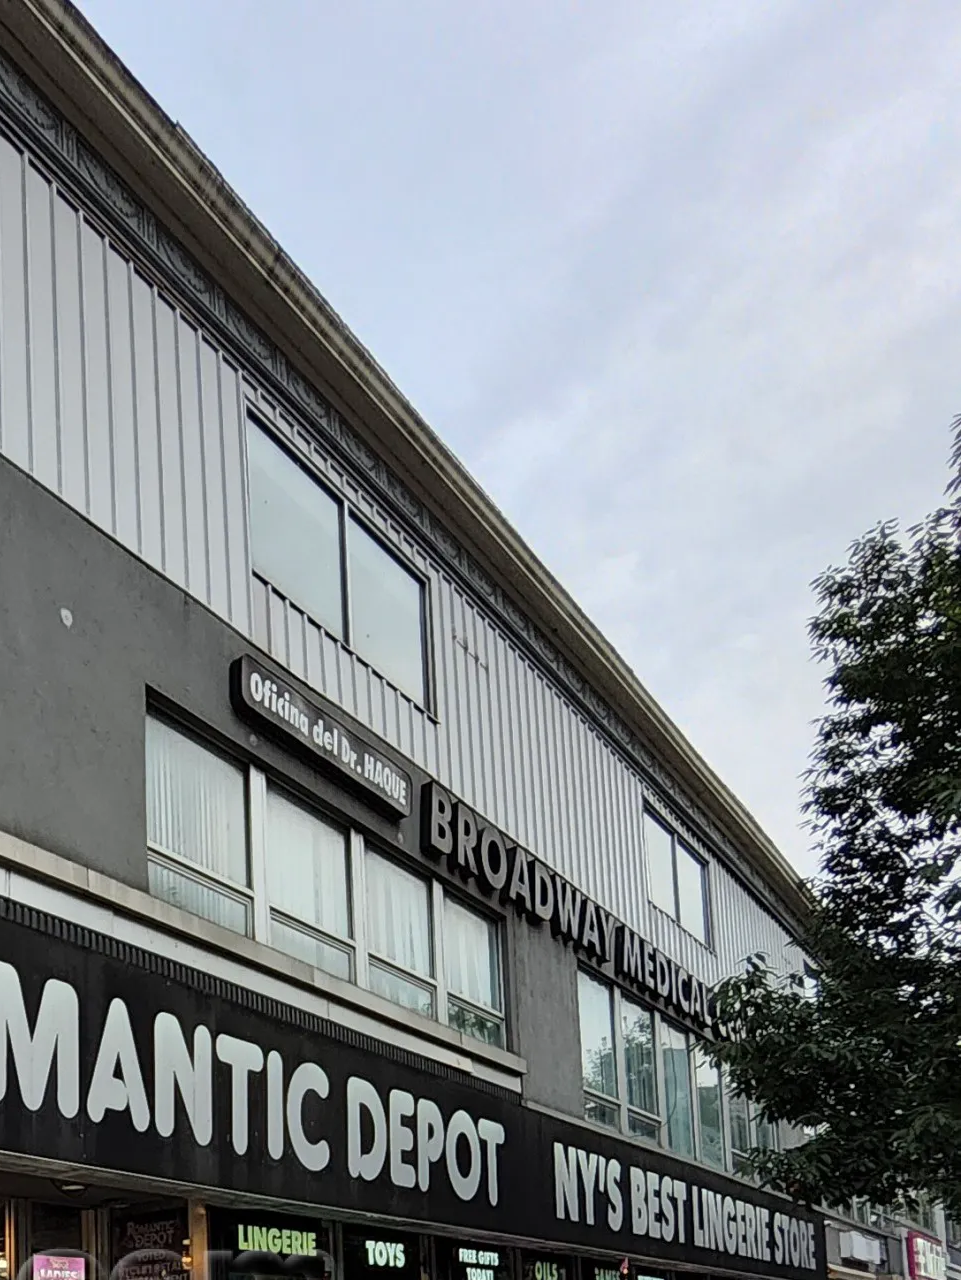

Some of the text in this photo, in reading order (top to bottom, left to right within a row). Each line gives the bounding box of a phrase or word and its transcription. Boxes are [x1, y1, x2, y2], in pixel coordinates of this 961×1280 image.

[250, 672, 407, 806] Oficina del Dr. HAQUE
[428, 780, 713, 1028] BROADWAY MEDICAL
[345, 1075, 506, 1208] DEPOT
[553, 1141, 817, 1271] NY'S BEST LINGERIE STORE
[237, 1223, 318, 1257] LINGERIE
[365, 1239, 406, 1268] TOYS
[458, 1247, 500, 1267] FREE GIFTS
